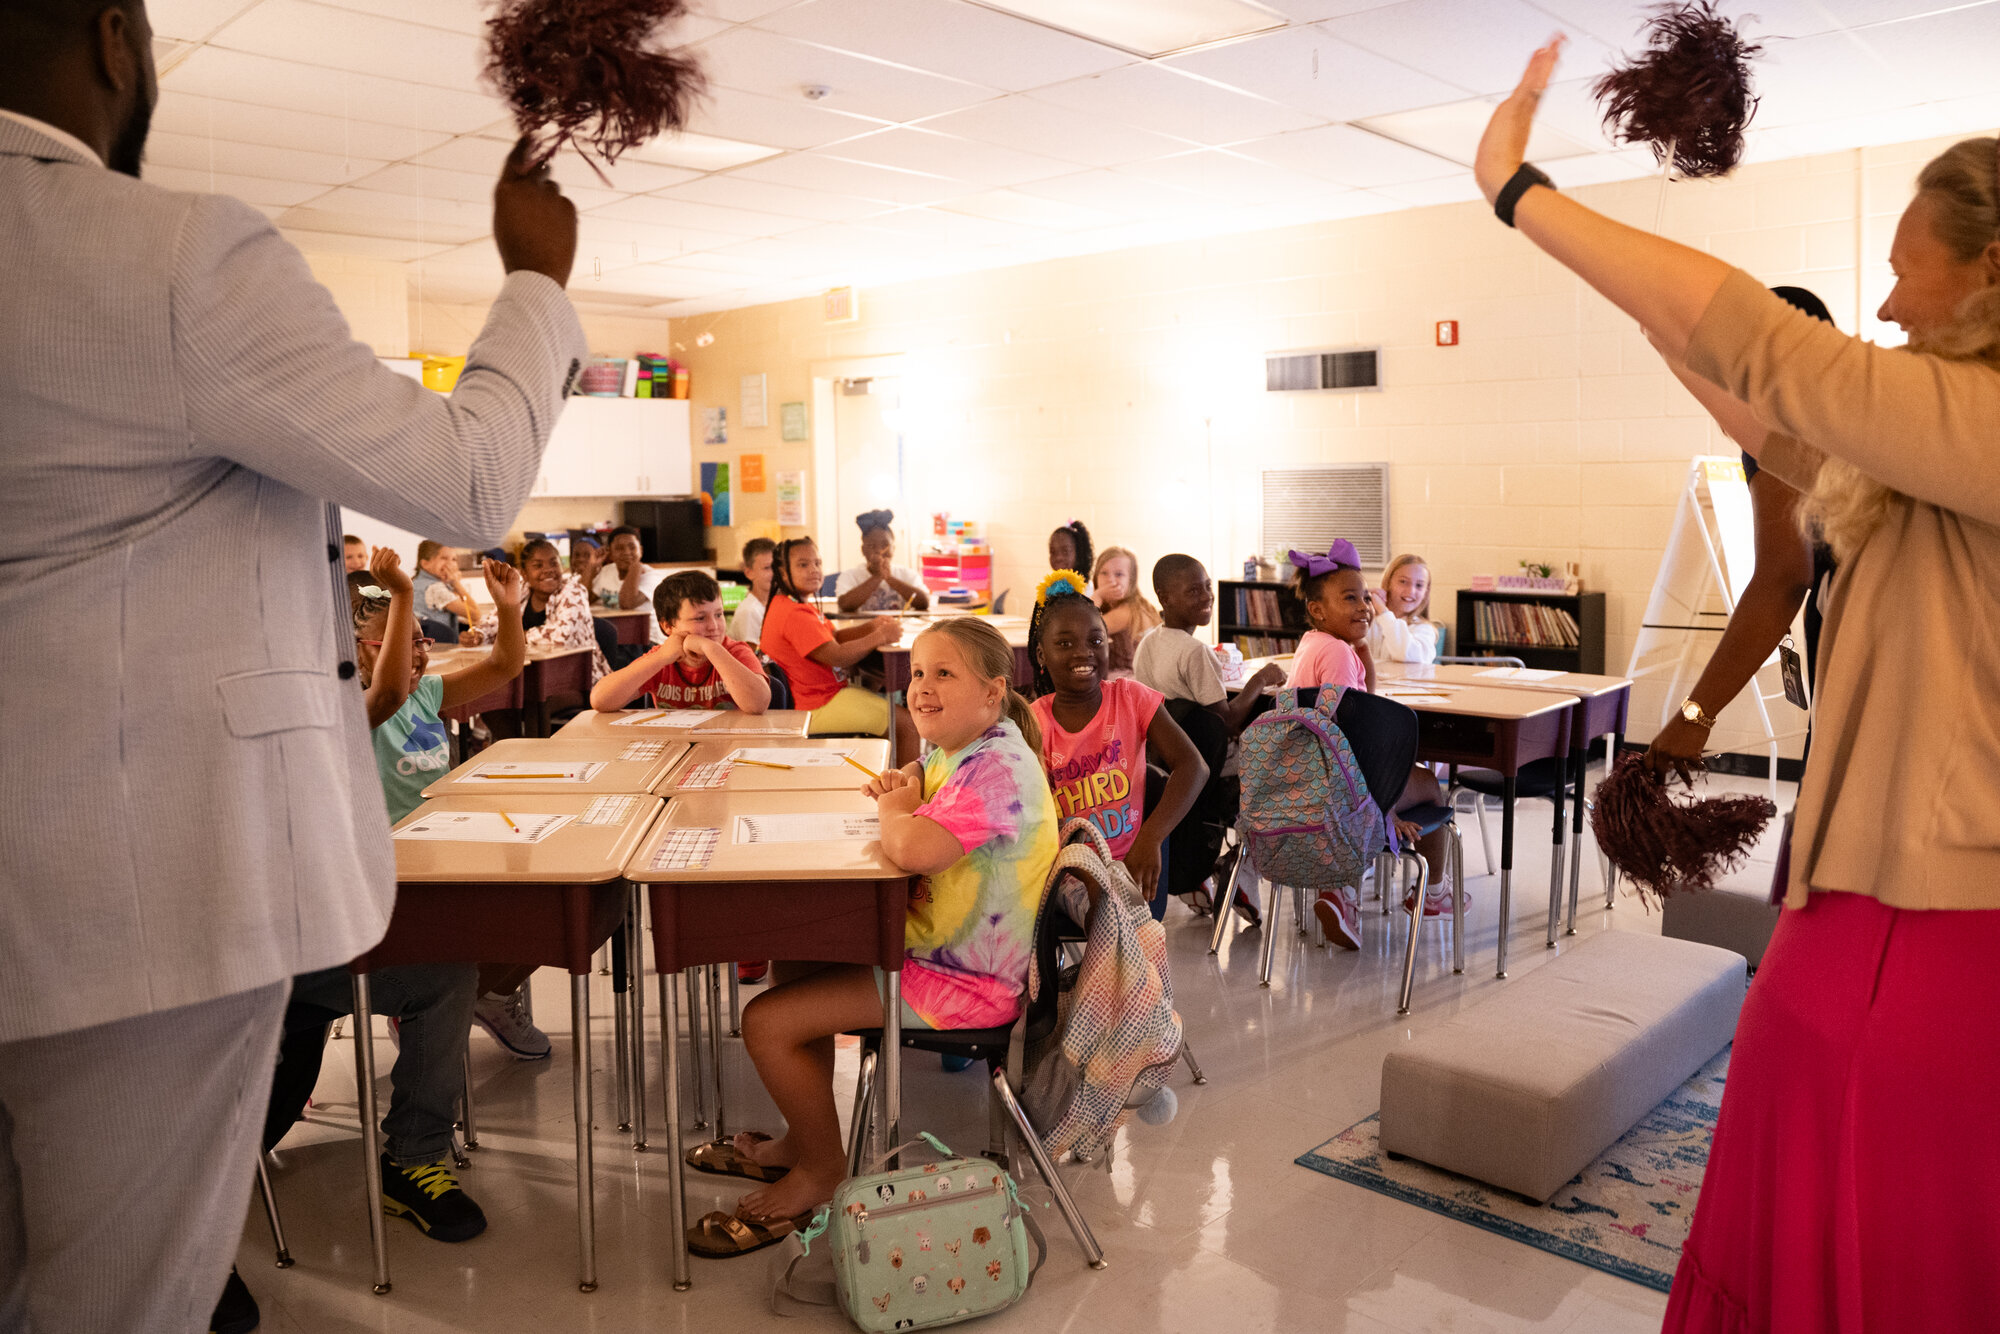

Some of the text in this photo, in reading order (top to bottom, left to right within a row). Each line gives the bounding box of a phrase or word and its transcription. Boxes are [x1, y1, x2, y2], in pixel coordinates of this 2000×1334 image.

[397, 742, 449, 775] adid
[1066, 752, 1102, 780] DAY
[1102, 740, 1121, 764] OF
[1053, 769, 1131, 819] THIRD
[1066, 803, 1134, 840] ADE
